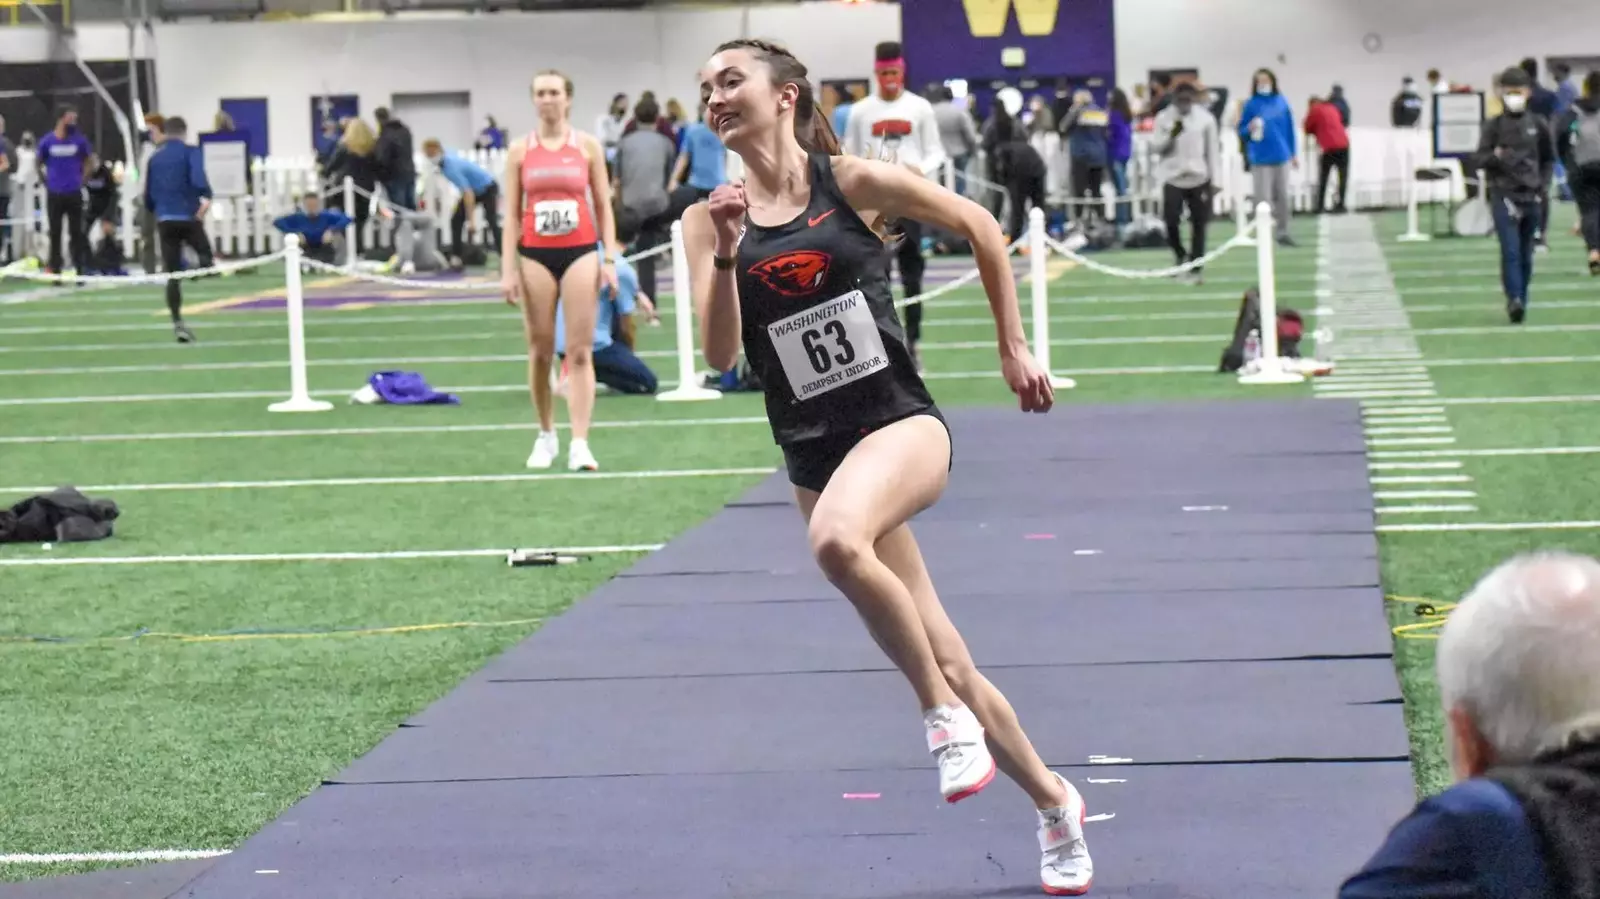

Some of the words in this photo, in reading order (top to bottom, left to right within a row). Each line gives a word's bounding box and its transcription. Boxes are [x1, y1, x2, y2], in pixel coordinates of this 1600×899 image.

[540, 210, 571, 231] 204
[774, 297, 857, 338] WASHINGTON
[801, 320, 855, 374] 63
[801, 371, 843, 395] DEMPSEY
[845, 356, 882, 378] INDOOR
